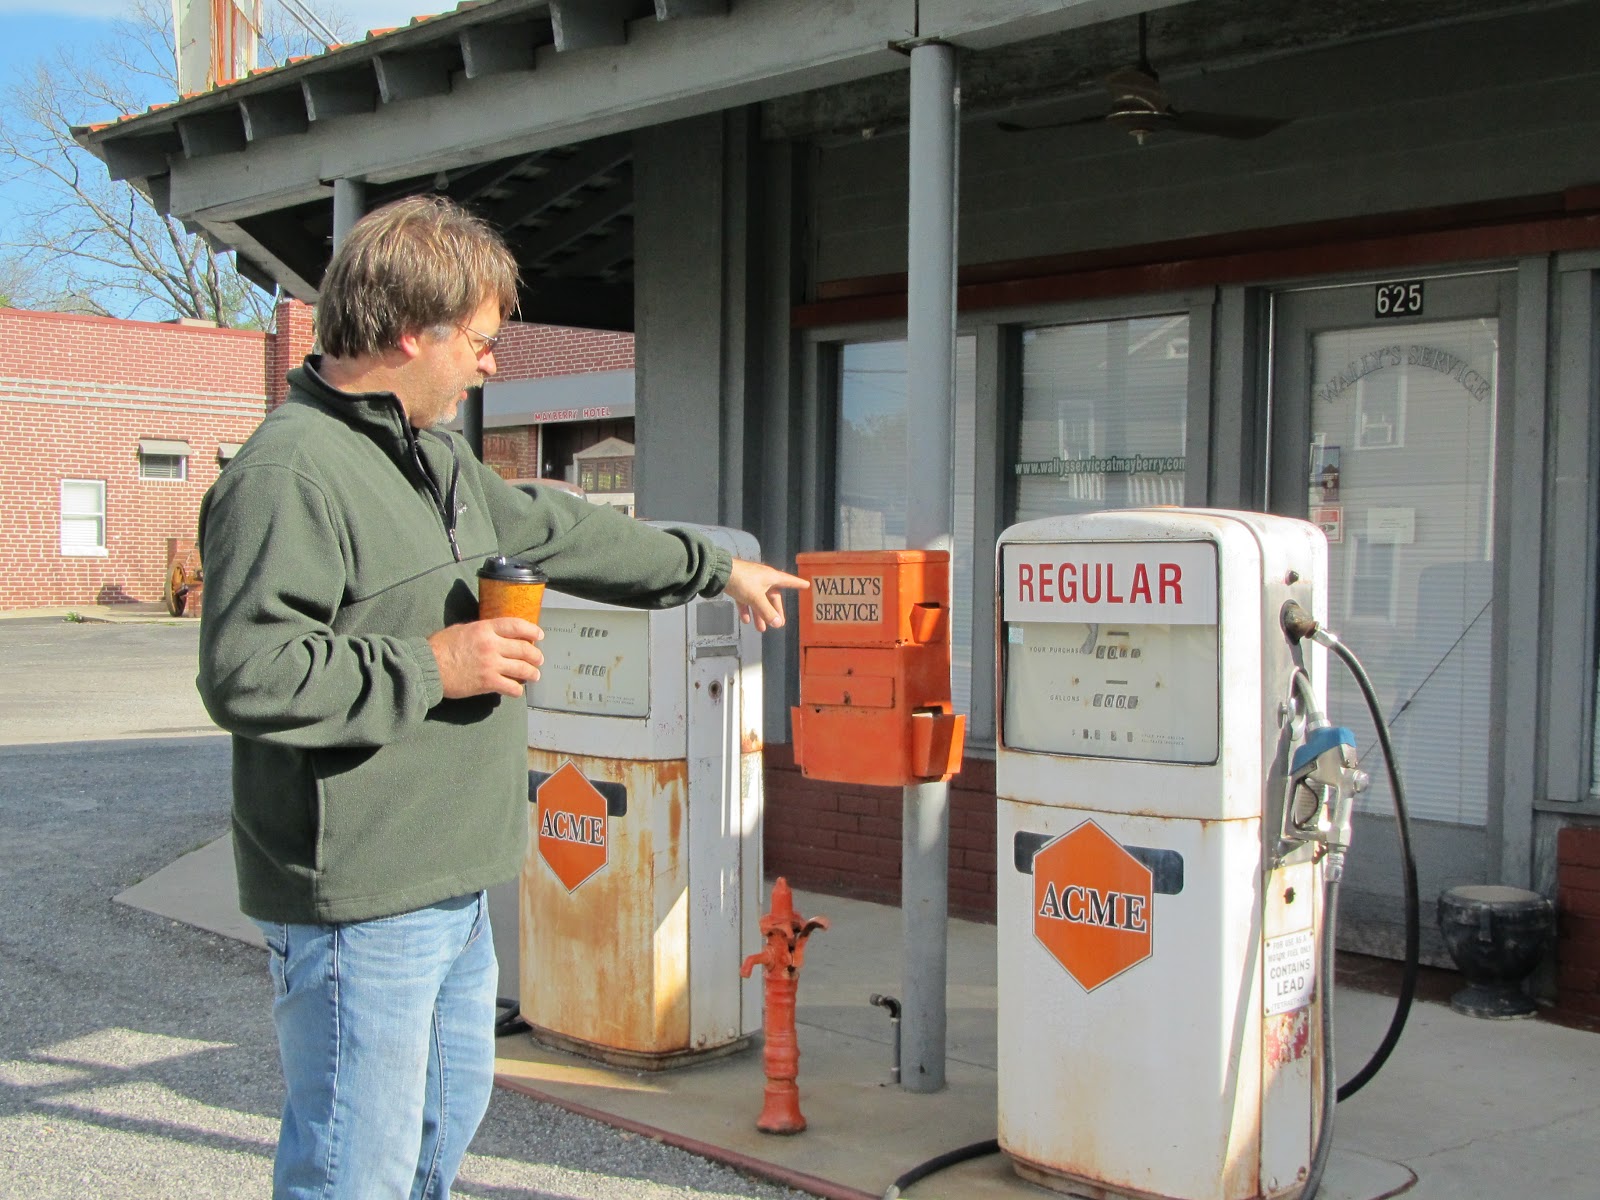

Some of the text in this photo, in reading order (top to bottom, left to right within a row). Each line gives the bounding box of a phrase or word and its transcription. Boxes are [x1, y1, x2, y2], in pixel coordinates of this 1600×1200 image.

[1377, 284, 1422, 314] 625
[1318, 345, 1492, 404] WALLY'S SERVICE
[534, 406, 611, 422] MAYBERRY HOTEL
[814, 577, 881, 596] WALLY'S
[1018, 562, 1184, 605] REGULAR
[815, 602, 879, 622] SERVICE
[1049, 694, 1080, 702] GALLONS
[541, 808, 604, 847] ACME
[1039, 881, 1147, 933] ACME
[1273, 940, 1284, 950] FOR
[1285, 937, 1295, 947] USE
[1296, 936, 1302, 944] AS
[1268, 945, 1311, 962] MOTOR FUEL ONLY
[1270, 959, 1311, 979] CONTAINS
[1277, 976, 1305, 996] LEAD
